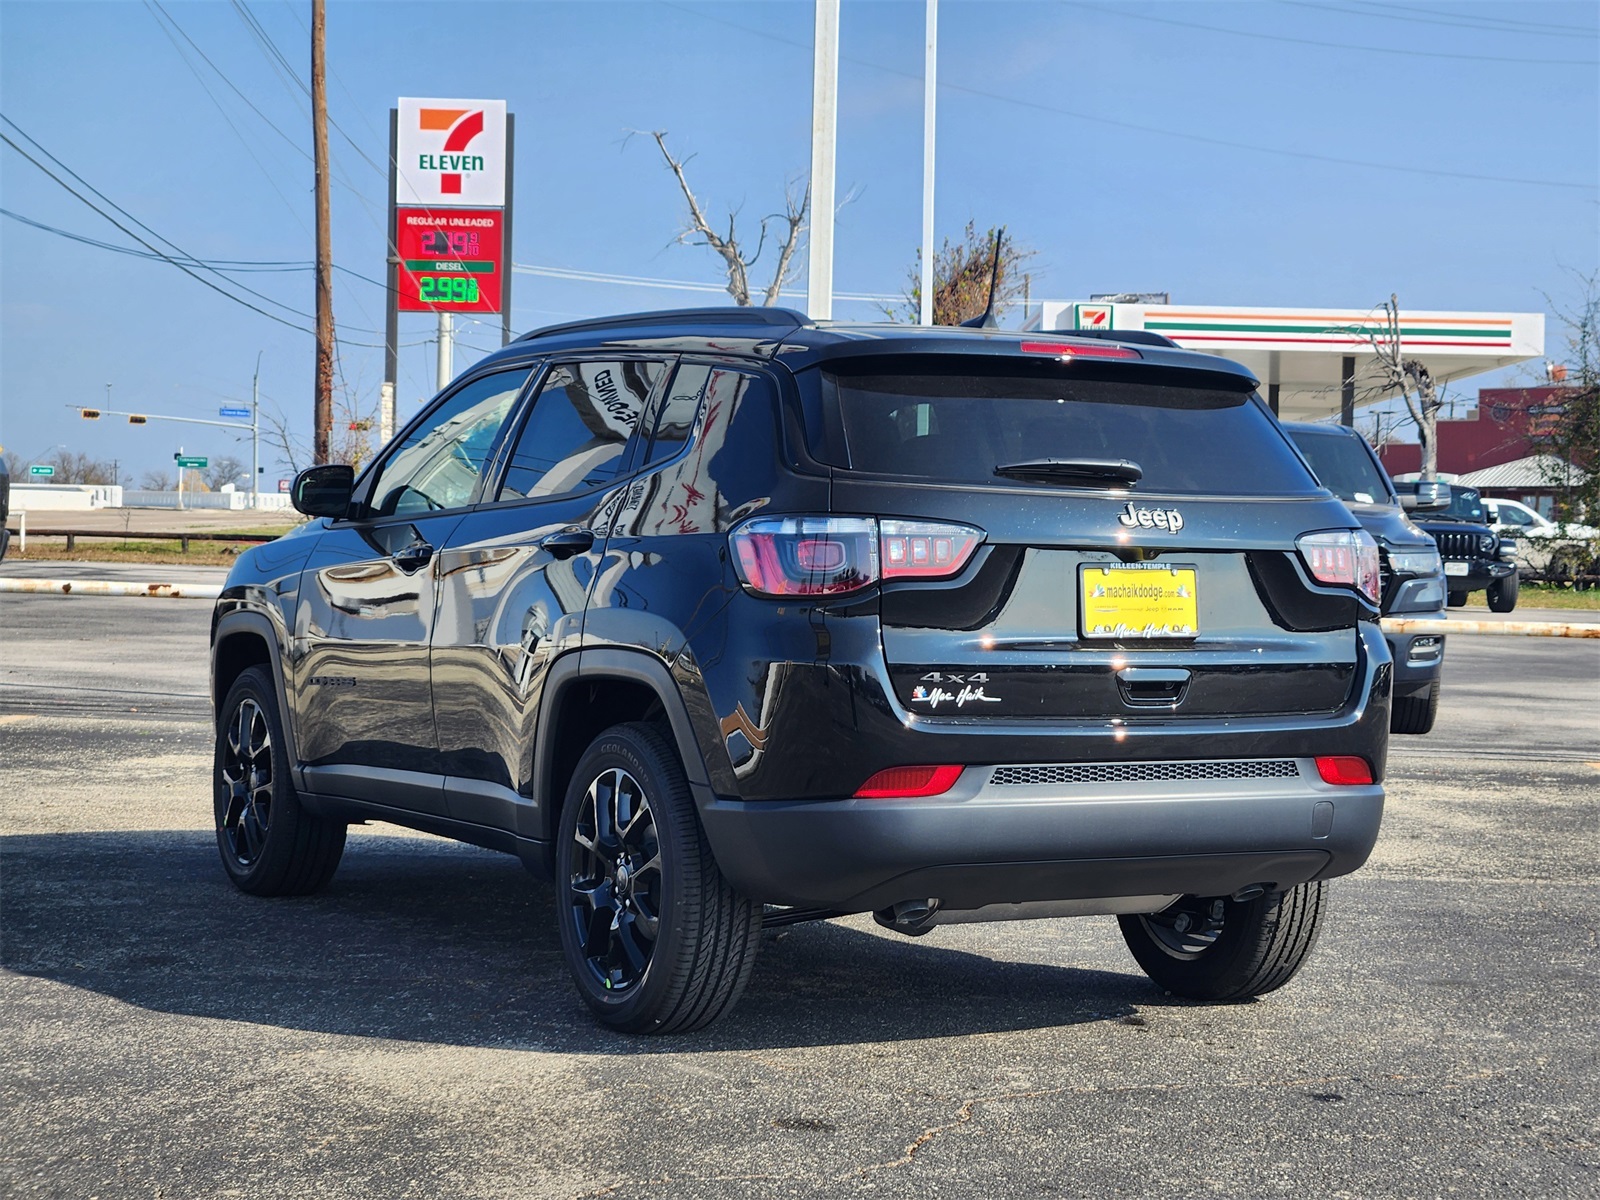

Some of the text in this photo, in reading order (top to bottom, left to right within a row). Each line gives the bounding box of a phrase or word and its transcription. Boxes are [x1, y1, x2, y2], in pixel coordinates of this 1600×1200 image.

[420, 108, 484, 193] 7
[406, 216, 495, 227] REGULAR UNLEADED
[435, 262, 464, 271] DIESEL
[1117, 501, 1185, 535] Jeep
[1109, 562, 1172, 570] KILLEEN-TEMPLE
[1106, 584, 1175, 601] machaikdodge.com
[919, 671, 990, 684] 4x4
[926, 685, 1000, 709] Mac Haik
